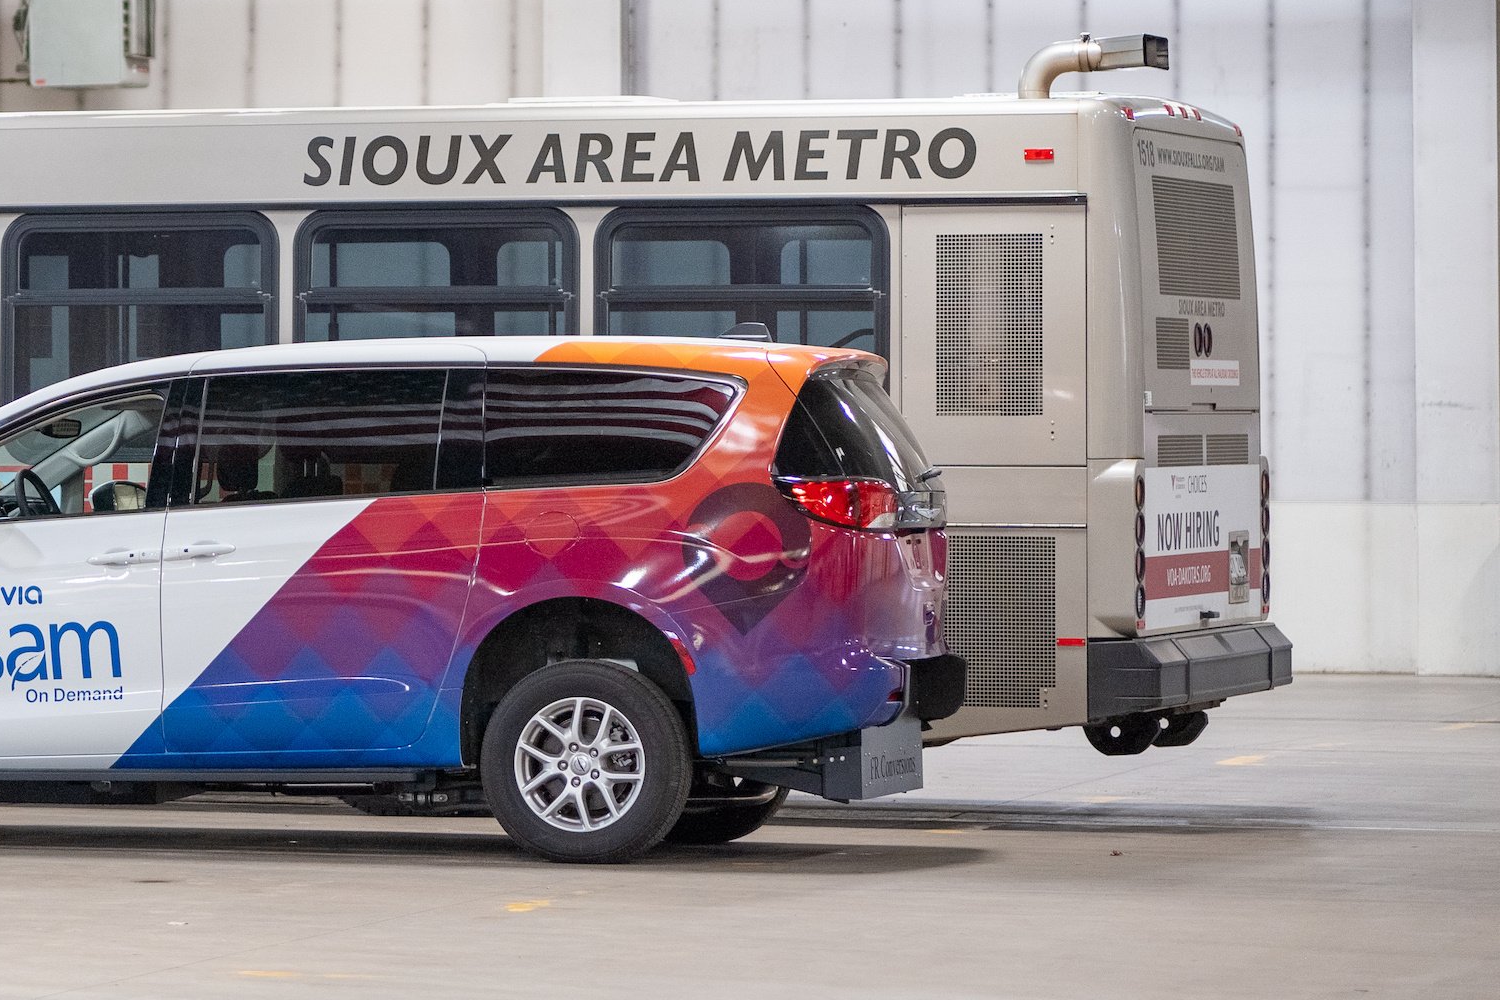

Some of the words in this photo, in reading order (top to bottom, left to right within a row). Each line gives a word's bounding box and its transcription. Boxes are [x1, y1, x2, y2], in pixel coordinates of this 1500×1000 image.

[303, 133, 513, 187] SIOUX
[525, 130, 701, 184] AREA
[722, 127, 977, 182] METRO
[1136, 140, 1156, 168] 1518
[1187, 474, 1208, 494] CHOICES
[1157, 512, 1183, 551] NOW
[1185, 510, 1220, 549] HIRING
[25, 688, 49, 703] On
[54, 686, 123, 702] Demand
